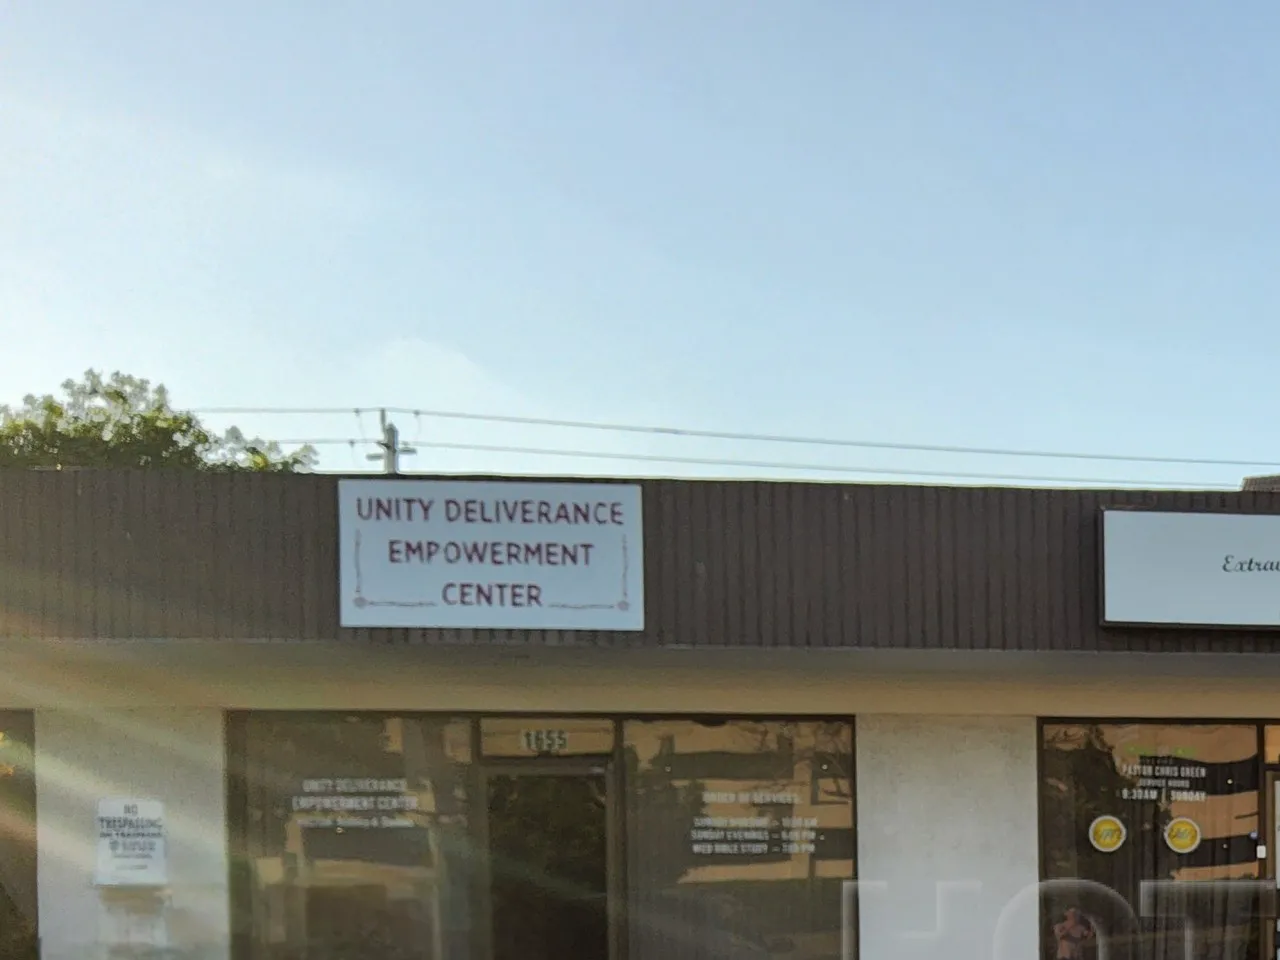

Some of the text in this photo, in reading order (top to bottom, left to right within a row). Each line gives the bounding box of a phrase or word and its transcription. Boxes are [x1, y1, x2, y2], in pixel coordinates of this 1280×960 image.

[357, 497, 625, 526] UNITY DELIVERANCE
[388, 540, 595, 567] EMPOWERMENT
[442, 582, 543, 607] CENTER
[524, 729, 567, 750] 1655
